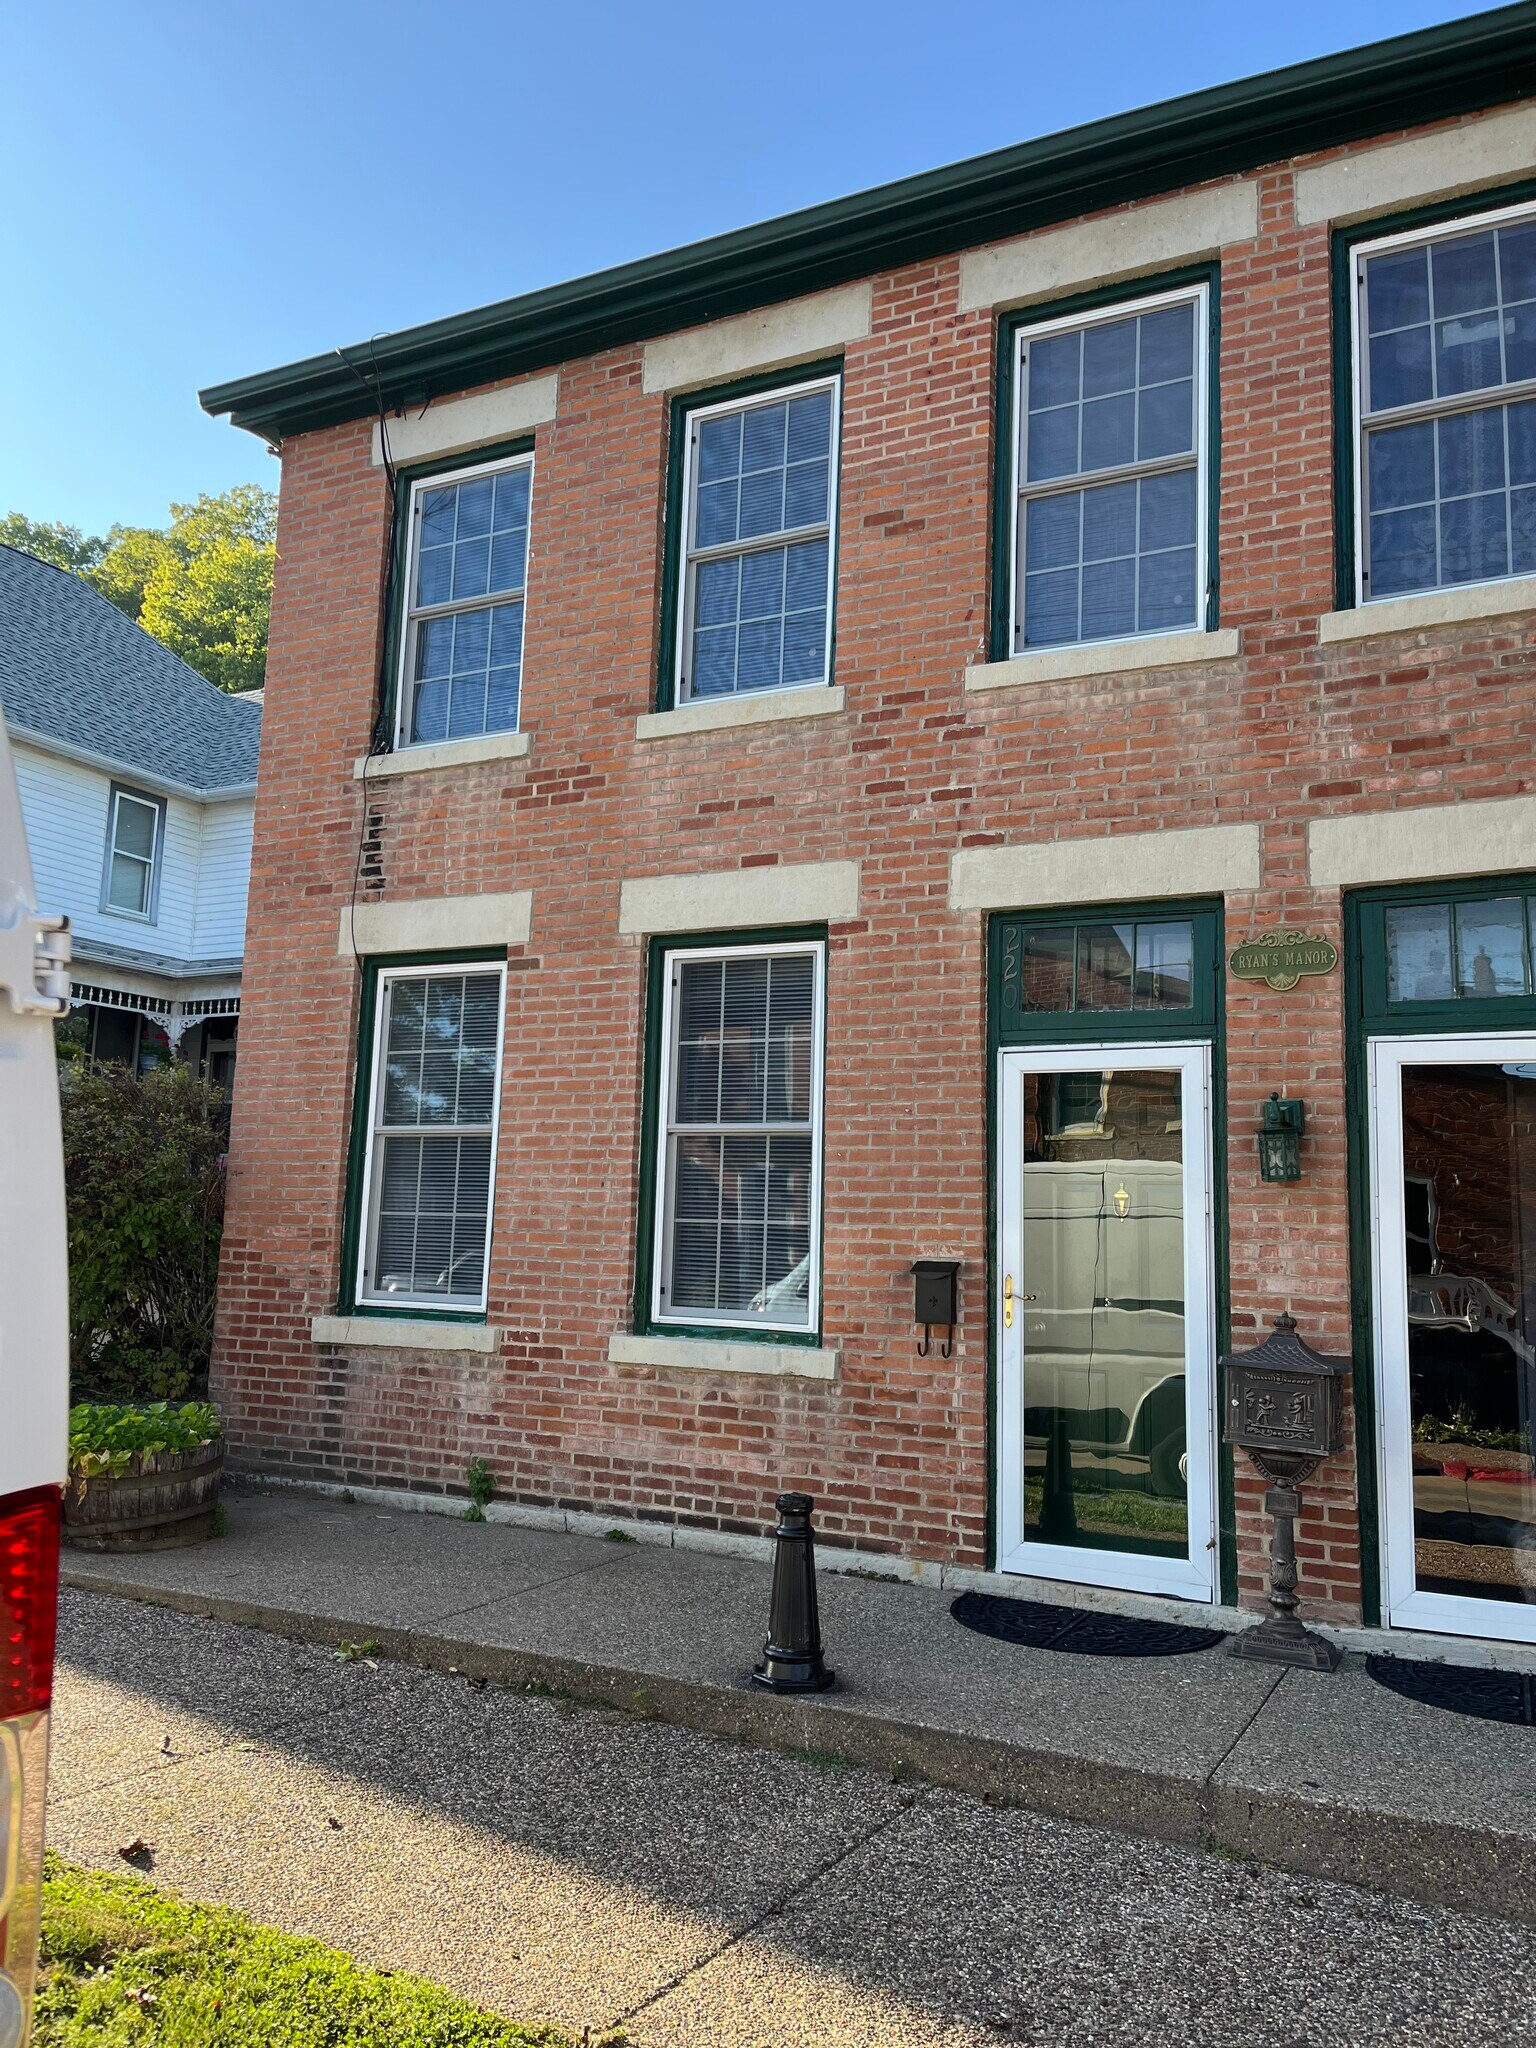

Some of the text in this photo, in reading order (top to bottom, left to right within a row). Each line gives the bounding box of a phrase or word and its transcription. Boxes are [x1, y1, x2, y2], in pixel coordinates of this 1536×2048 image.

[1002, 927, 1020, 1009] 220
[1238, 950, 1329, 969] RYAN'S MANOR
